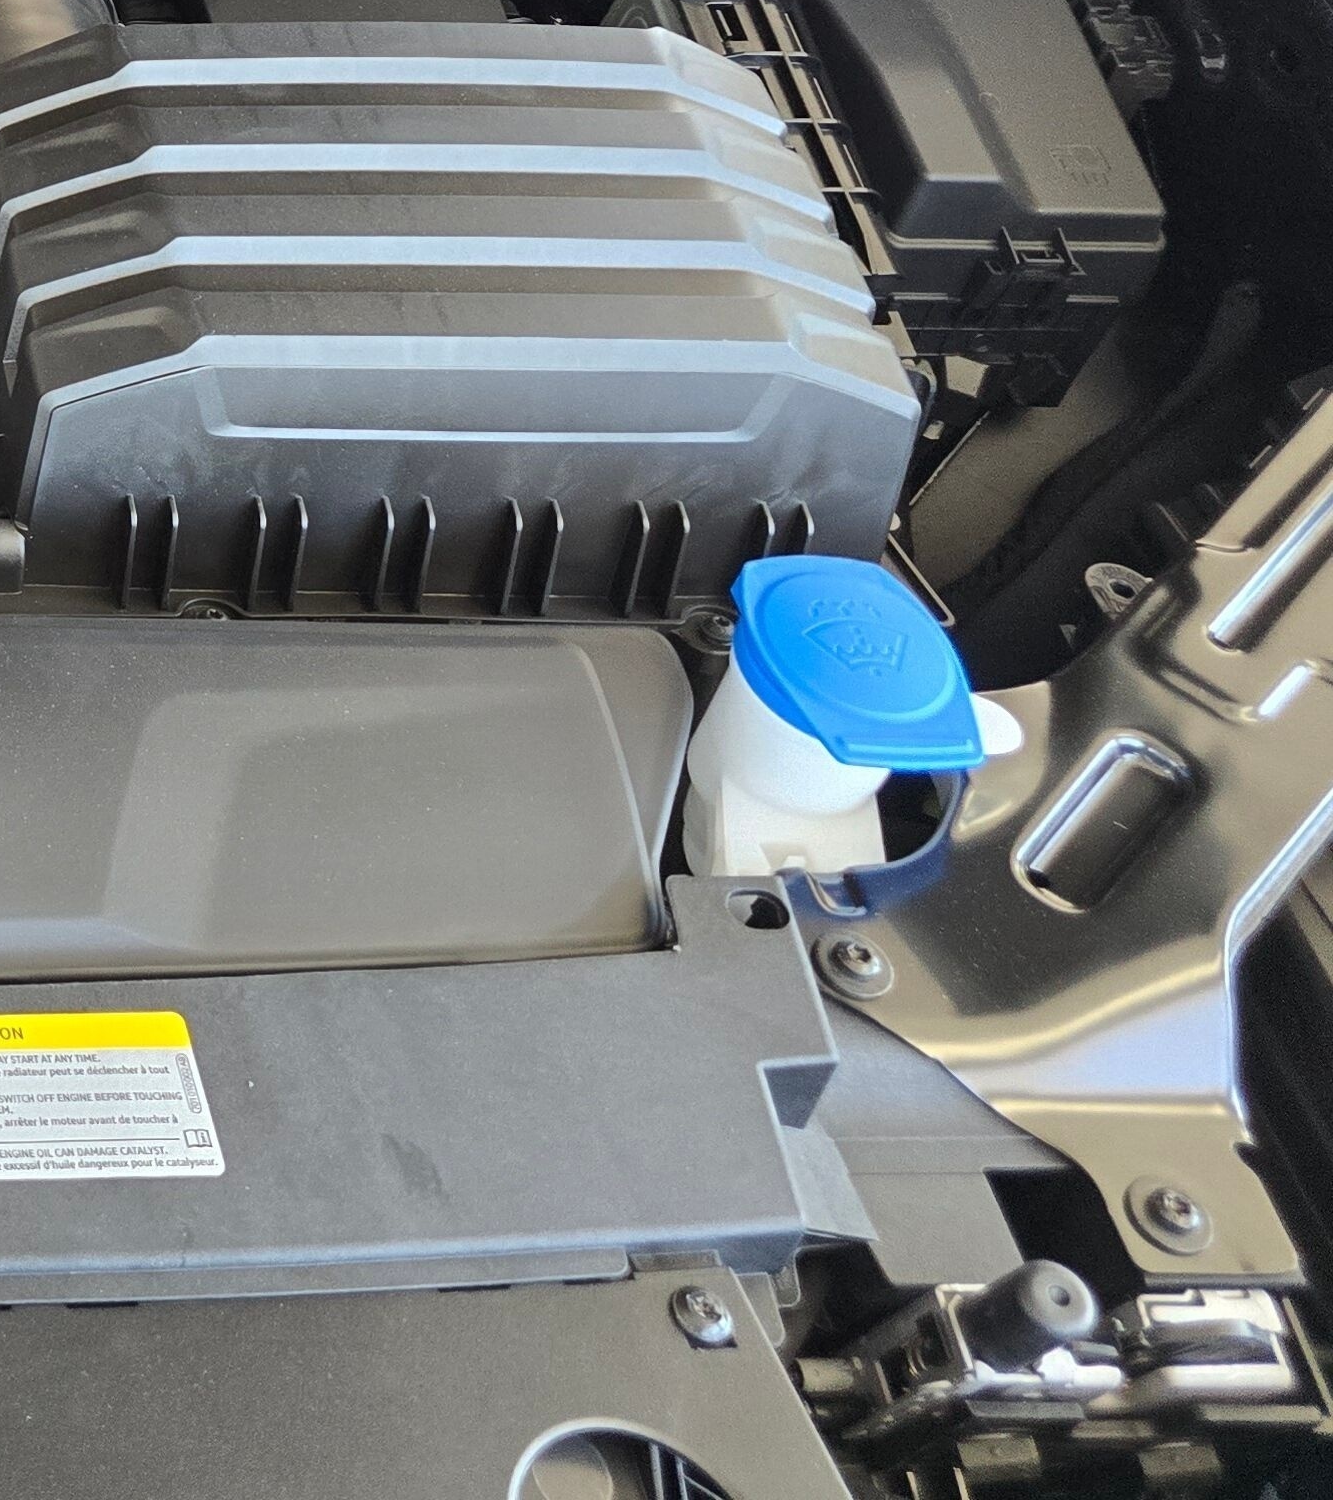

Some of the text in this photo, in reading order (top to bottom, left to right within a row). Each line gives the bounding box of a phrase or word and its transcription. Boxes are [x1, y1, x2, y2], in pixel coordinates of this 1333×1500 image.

[11, 1056, 39, 1064] START
[42, 1055, 52, 1063] AT
[55, 1055, 73, 1063] ANY
[3, 1068, 46, 1076] radiateur
[50, 1066, 71, 1077] peut
[87, 1065, 138, 1074] déclencher
[149, 1066, 169, 1074] tout
[36, 1094, 55, 1102] OFF
[57, 1093, 91, 1102] ENGINE
[95, 1092, 132, 1100] BEFORE
[134, 1092, 182, 1100] TOUCHING
[4, 1118, 37, 1126] arrêter
[39, 1117, 48, 1125] le
[89, 1116, 116, 1124] avant
[119, 1115, 130, 1124] de
[133, 1115, 169, 1124] toucher
[0, 1149, 33, 1158] ENGINE
[37, 1149, 53, 1157] OIL
[55, 1148, 74, 1156] CAN
[77, 1146, 118, 1156] DAMAGE
[120, 1146, 168, 1155] CATALYST.
[3, 1161, 41, 1170] excessif
[78, 1159, 129, 1170] dangereux
[131, 1159, 153, 1168] pour
[155, 1158, 164, 1166] le
[166, 1157, 218, 1168] catalyseur.
